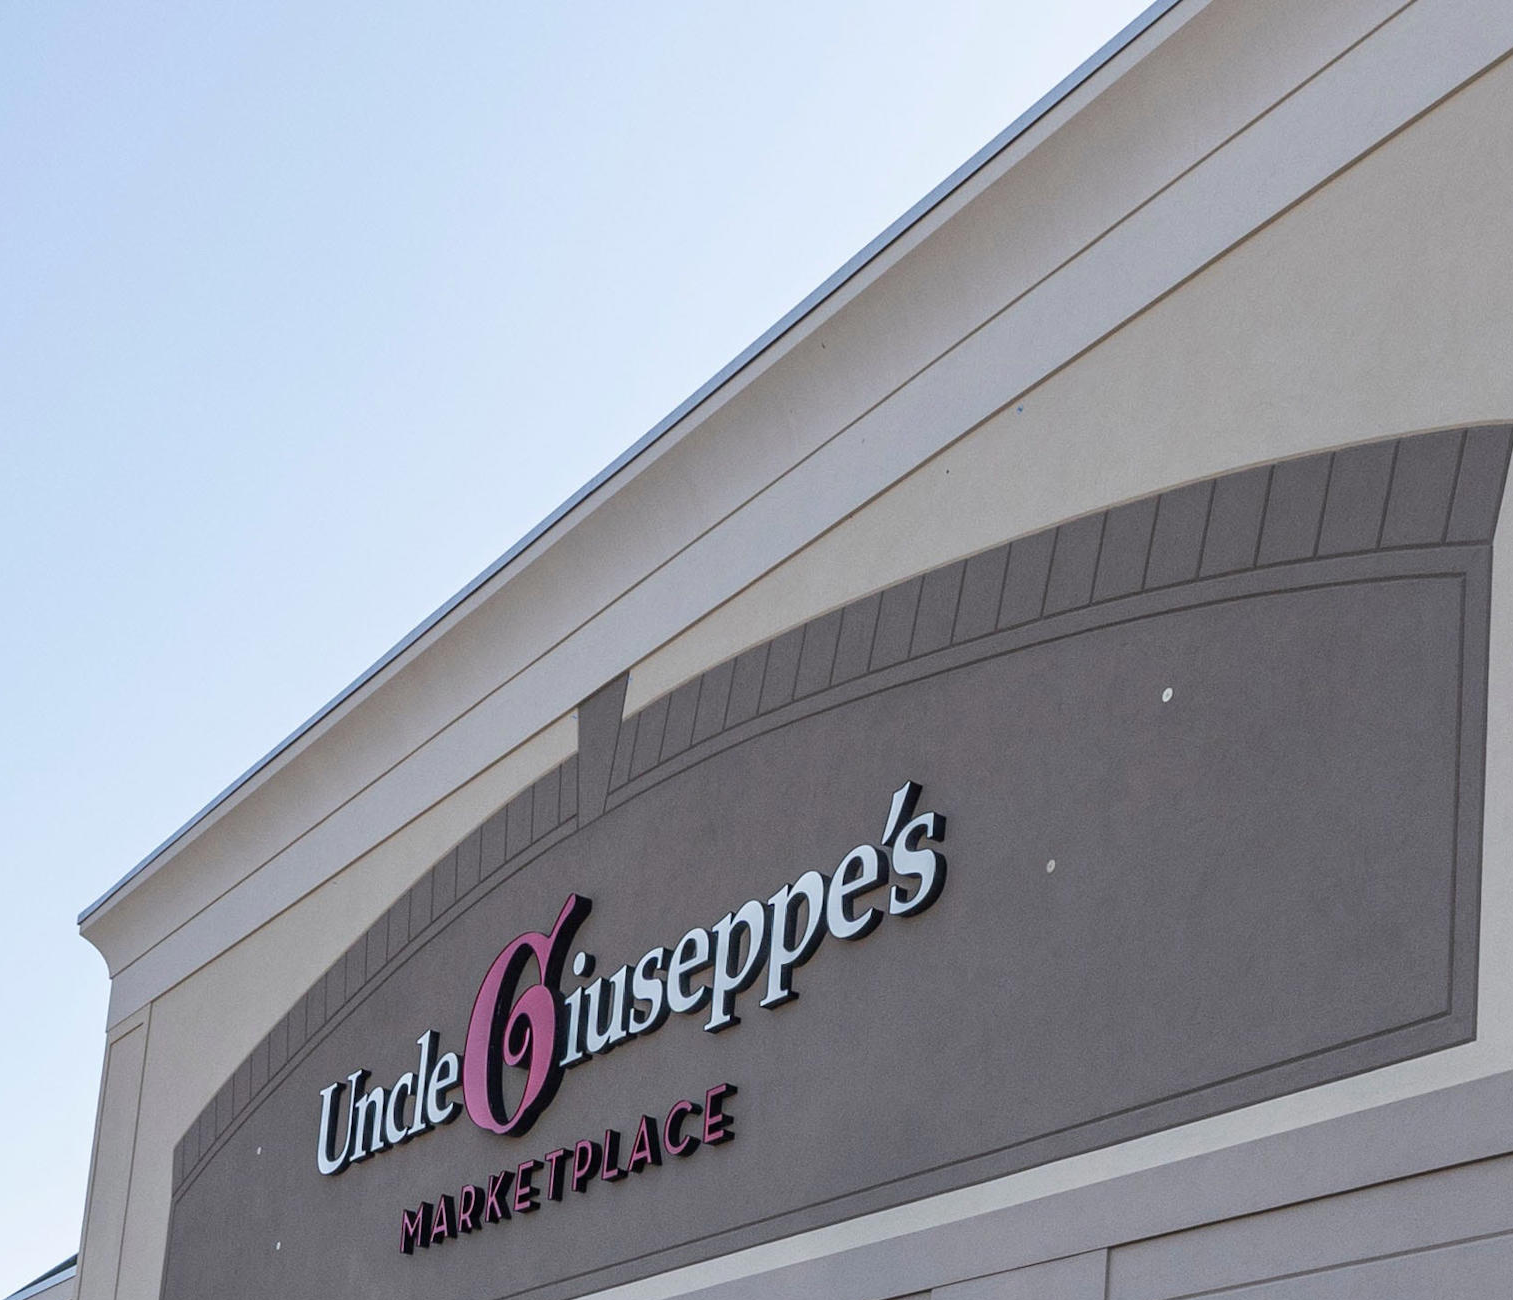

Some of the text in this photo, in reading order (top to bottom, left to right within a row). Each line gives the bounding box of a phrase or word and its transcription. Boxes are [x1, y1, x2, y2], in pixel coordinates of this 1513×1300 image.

[317, 780, 947, 1175] Uncle Giuseppe's
[399, 1083, 739, 1256] MARKETPLACE
